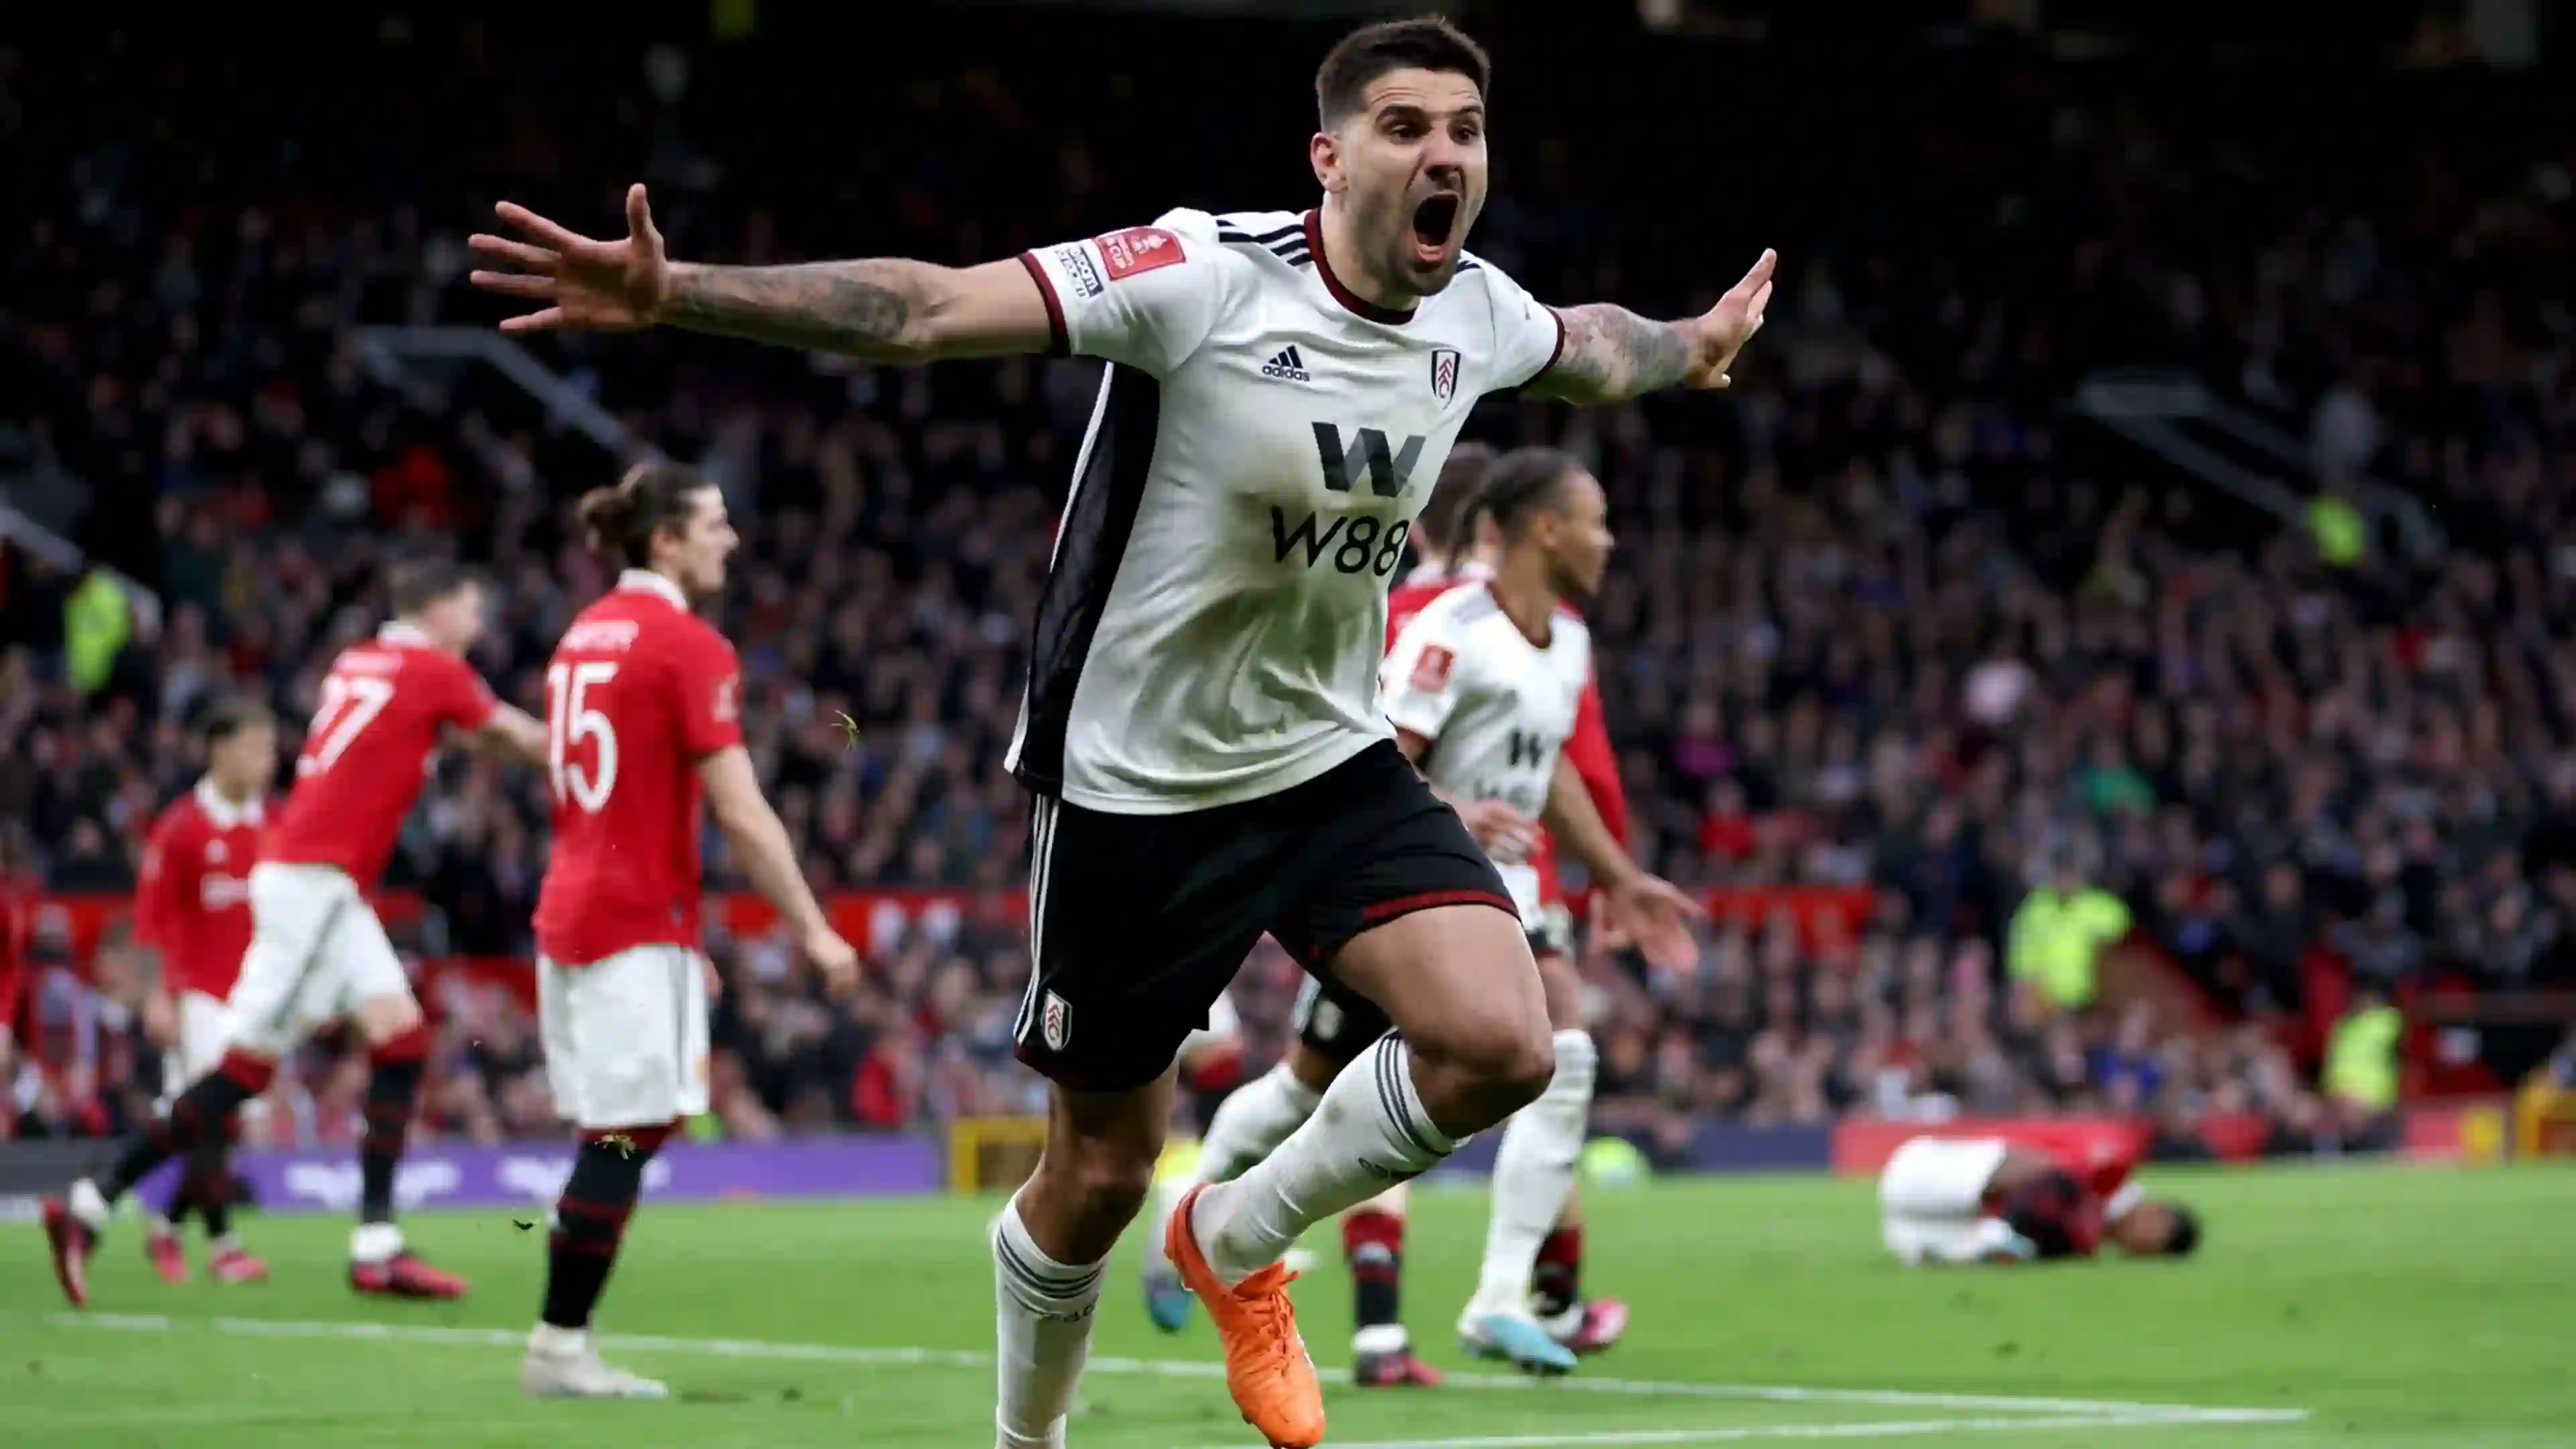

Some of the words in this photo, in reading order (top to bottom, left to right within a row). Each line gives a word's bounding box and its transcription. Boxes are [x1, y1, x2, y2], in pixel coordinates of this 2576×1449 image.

[1262, 365, 1310, 382] adidas
[1311, 421, 1426, 498] W
[1271, 504, 1410, 577] W88
[548, 661, 619, 814] 15
